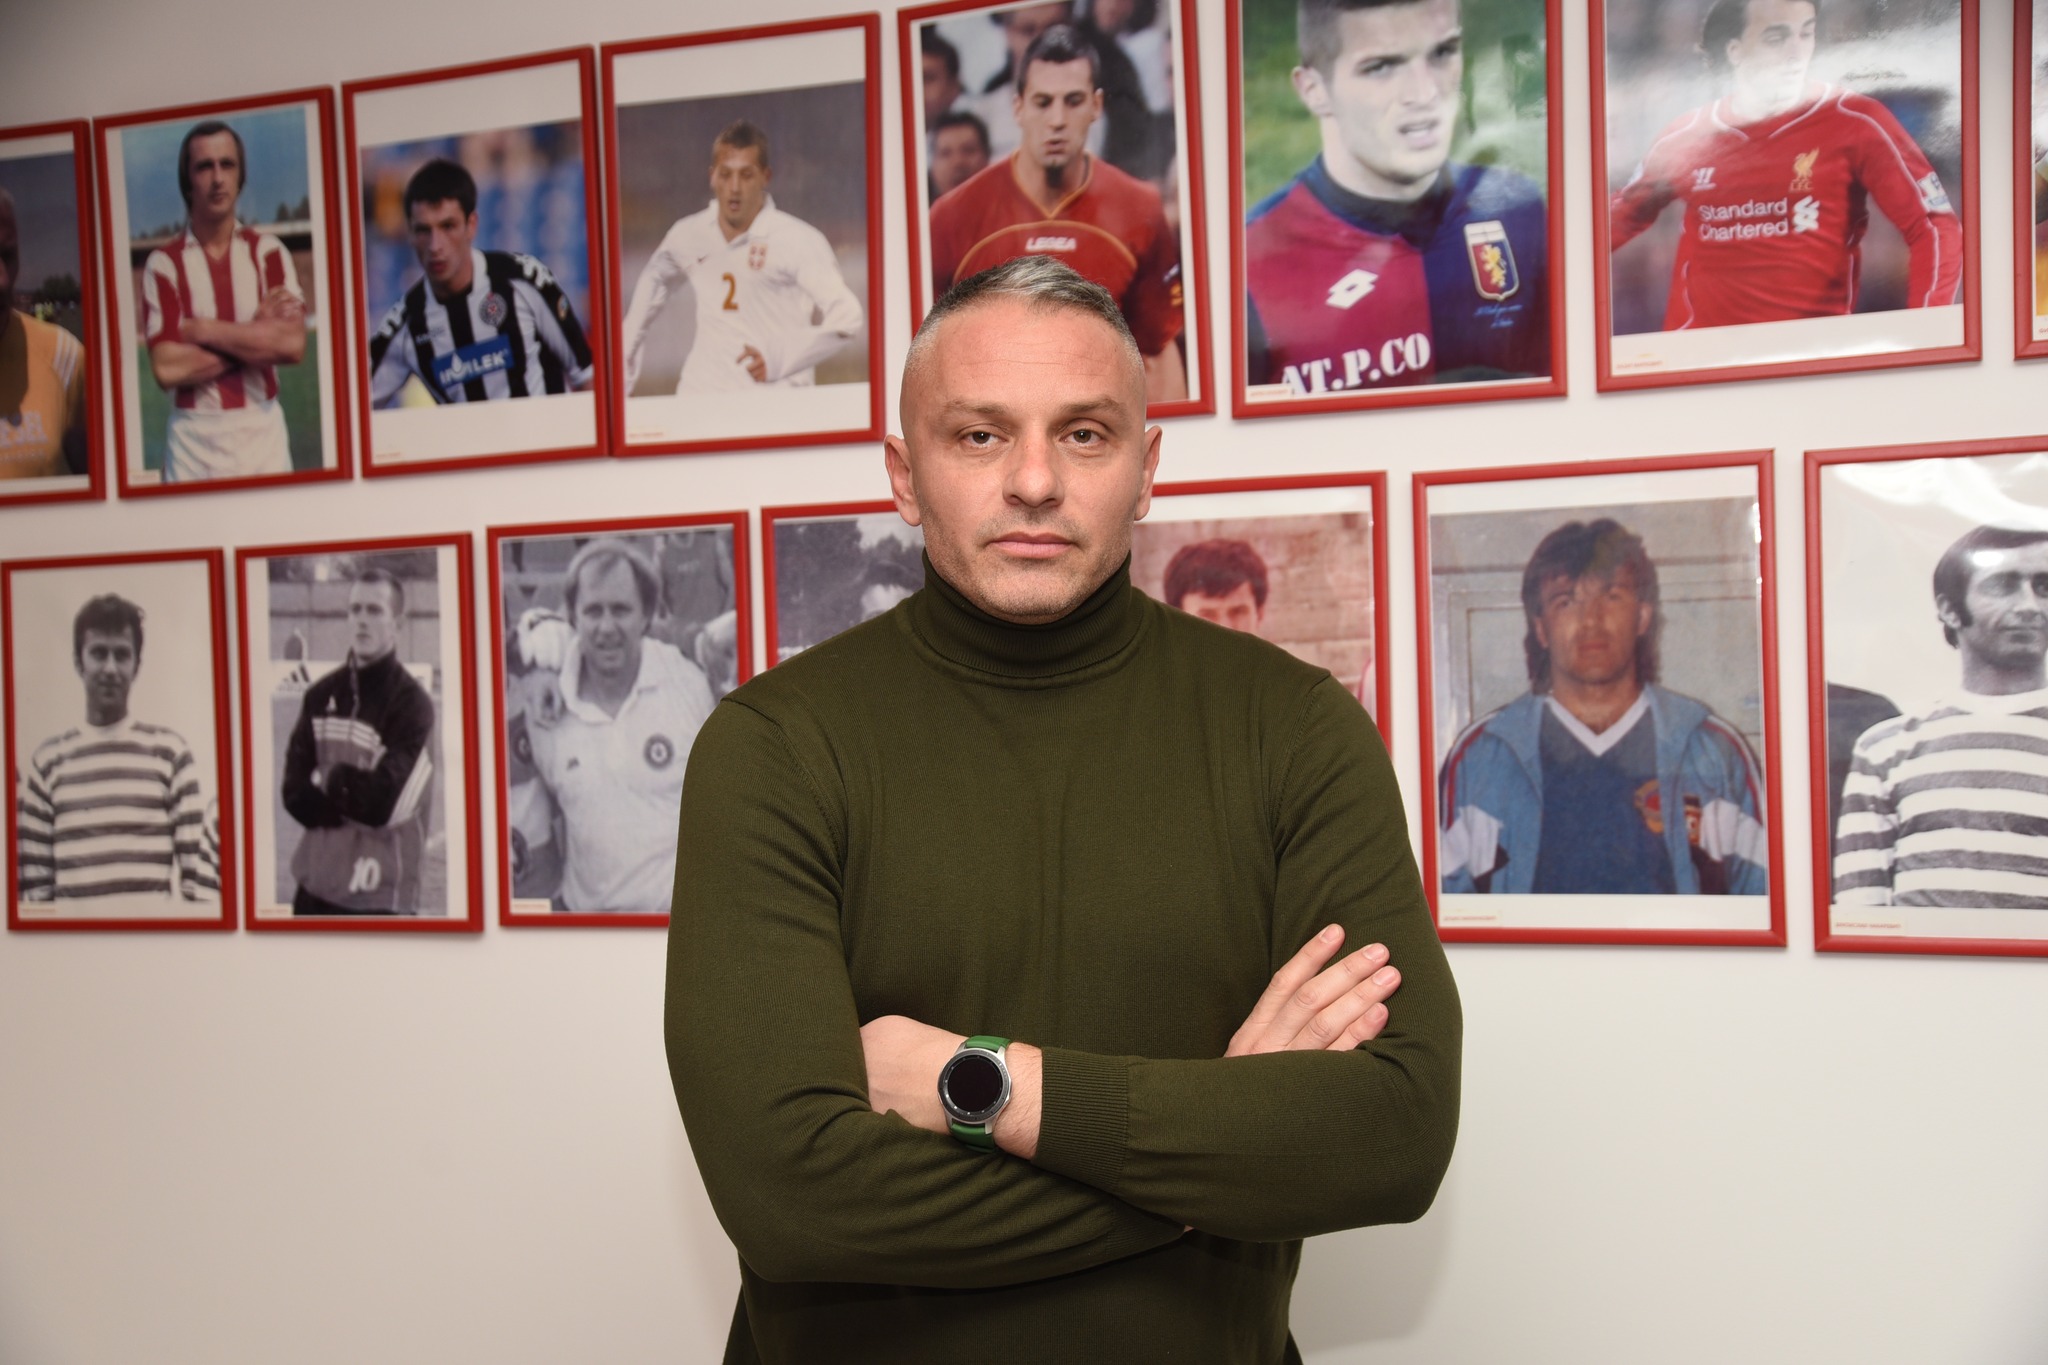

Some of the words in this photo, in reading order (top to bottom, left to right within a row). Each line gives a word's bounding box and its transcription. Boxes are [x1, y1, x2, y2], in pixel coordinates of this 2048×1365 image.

[1699, 198, 1788, 221] Standard
[1700, 218, 1789, 241] Chartered
[722, 272, 739, 311] 2
[349, 856, 381, 893] 10
